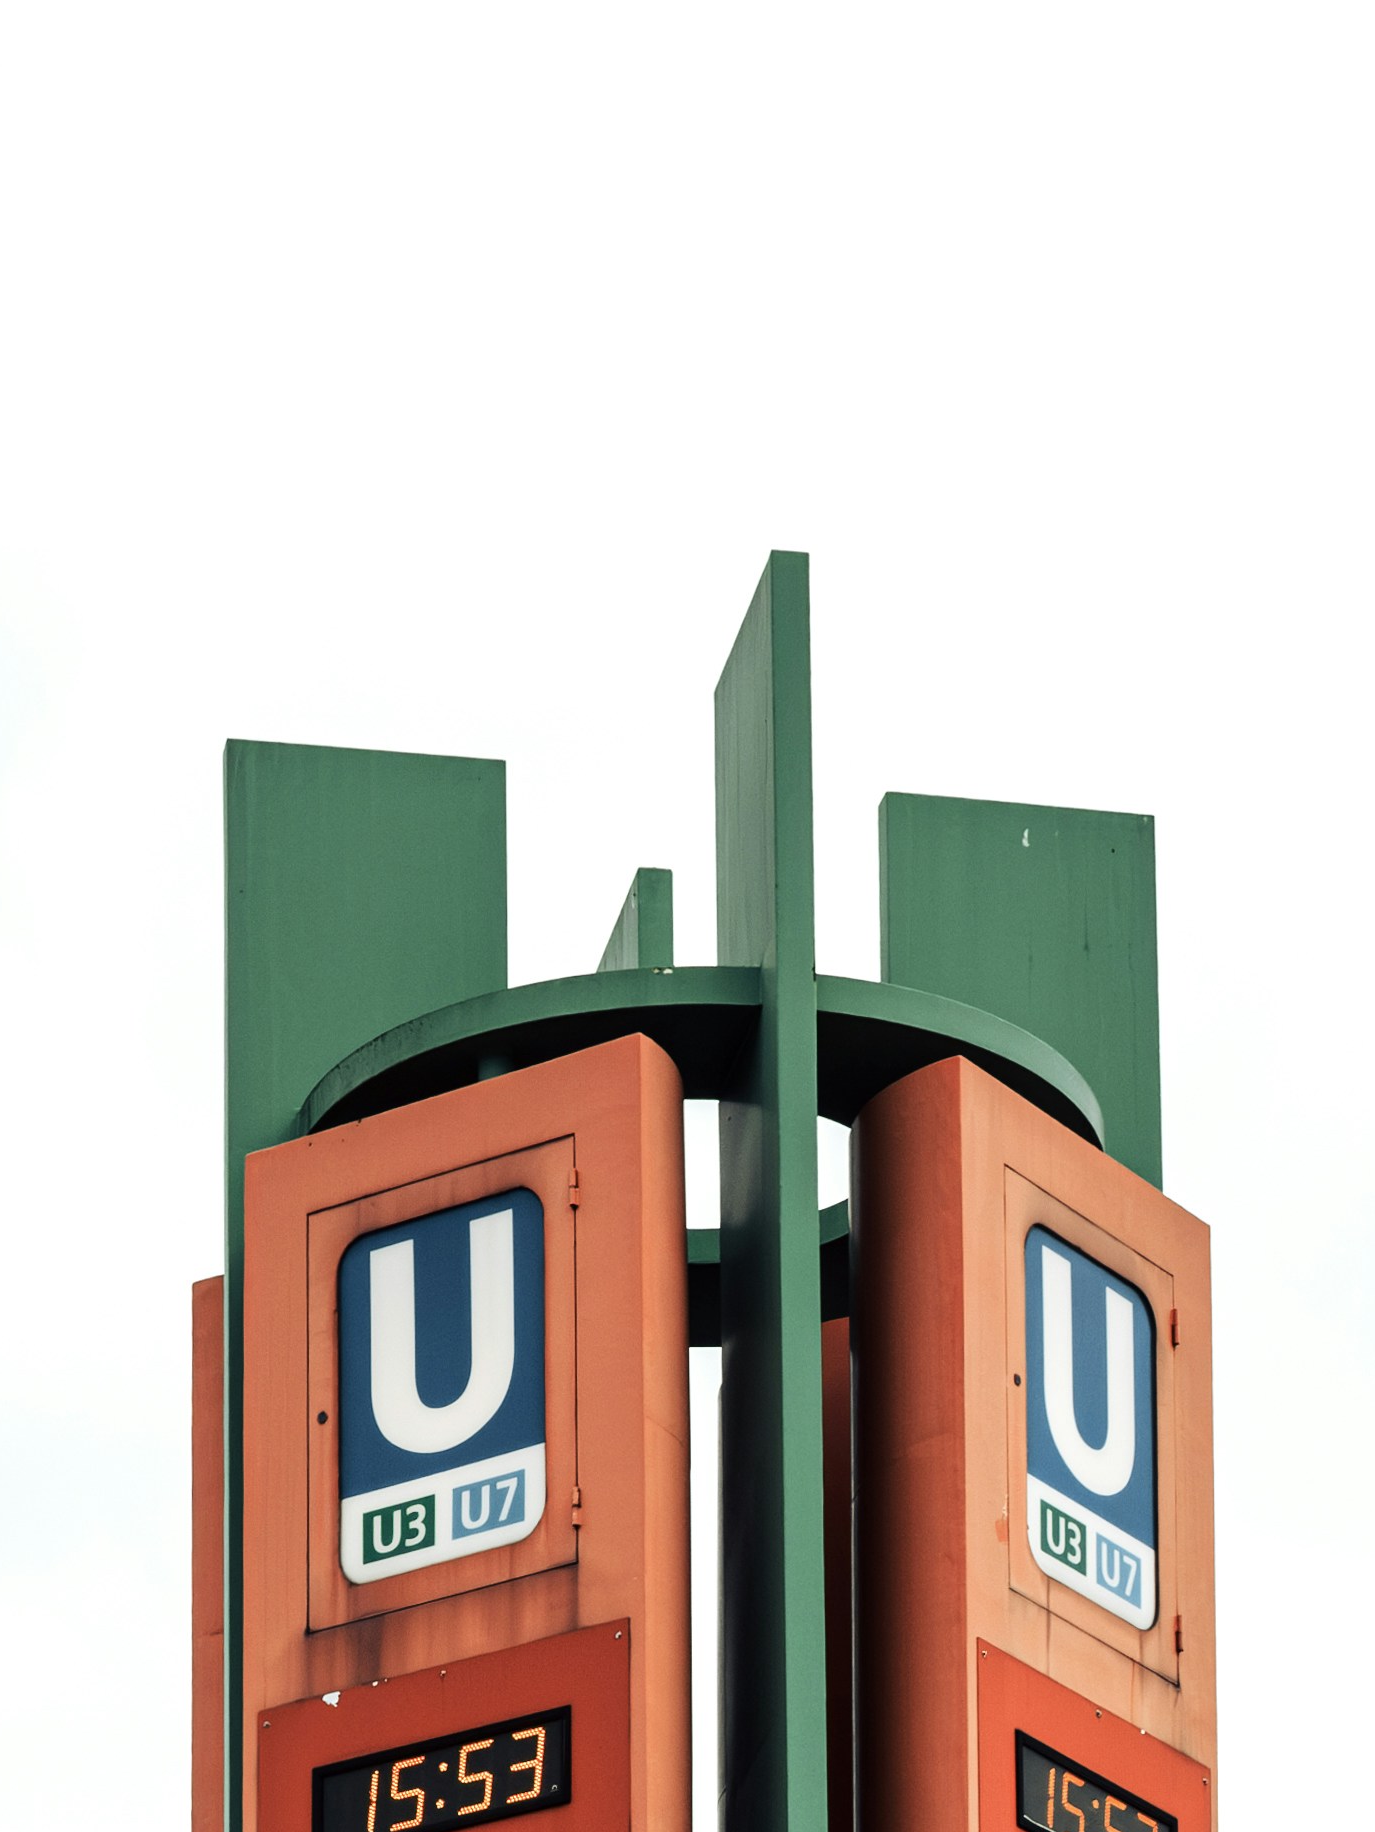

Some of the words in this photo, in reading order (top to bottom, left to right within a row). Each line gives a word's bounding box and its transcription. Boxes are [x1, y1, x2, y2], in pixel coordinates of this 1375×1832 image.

[369, 1207, 515, 1454] U
[1040, 1243, 1137, 1497] U
[369, 1501, 429, 1556] U3
[459, 1476, 520, 1531] U7
[1046, 1508, 1084, 1567] U3
[1098, 1546, 1139, 1602] U7
